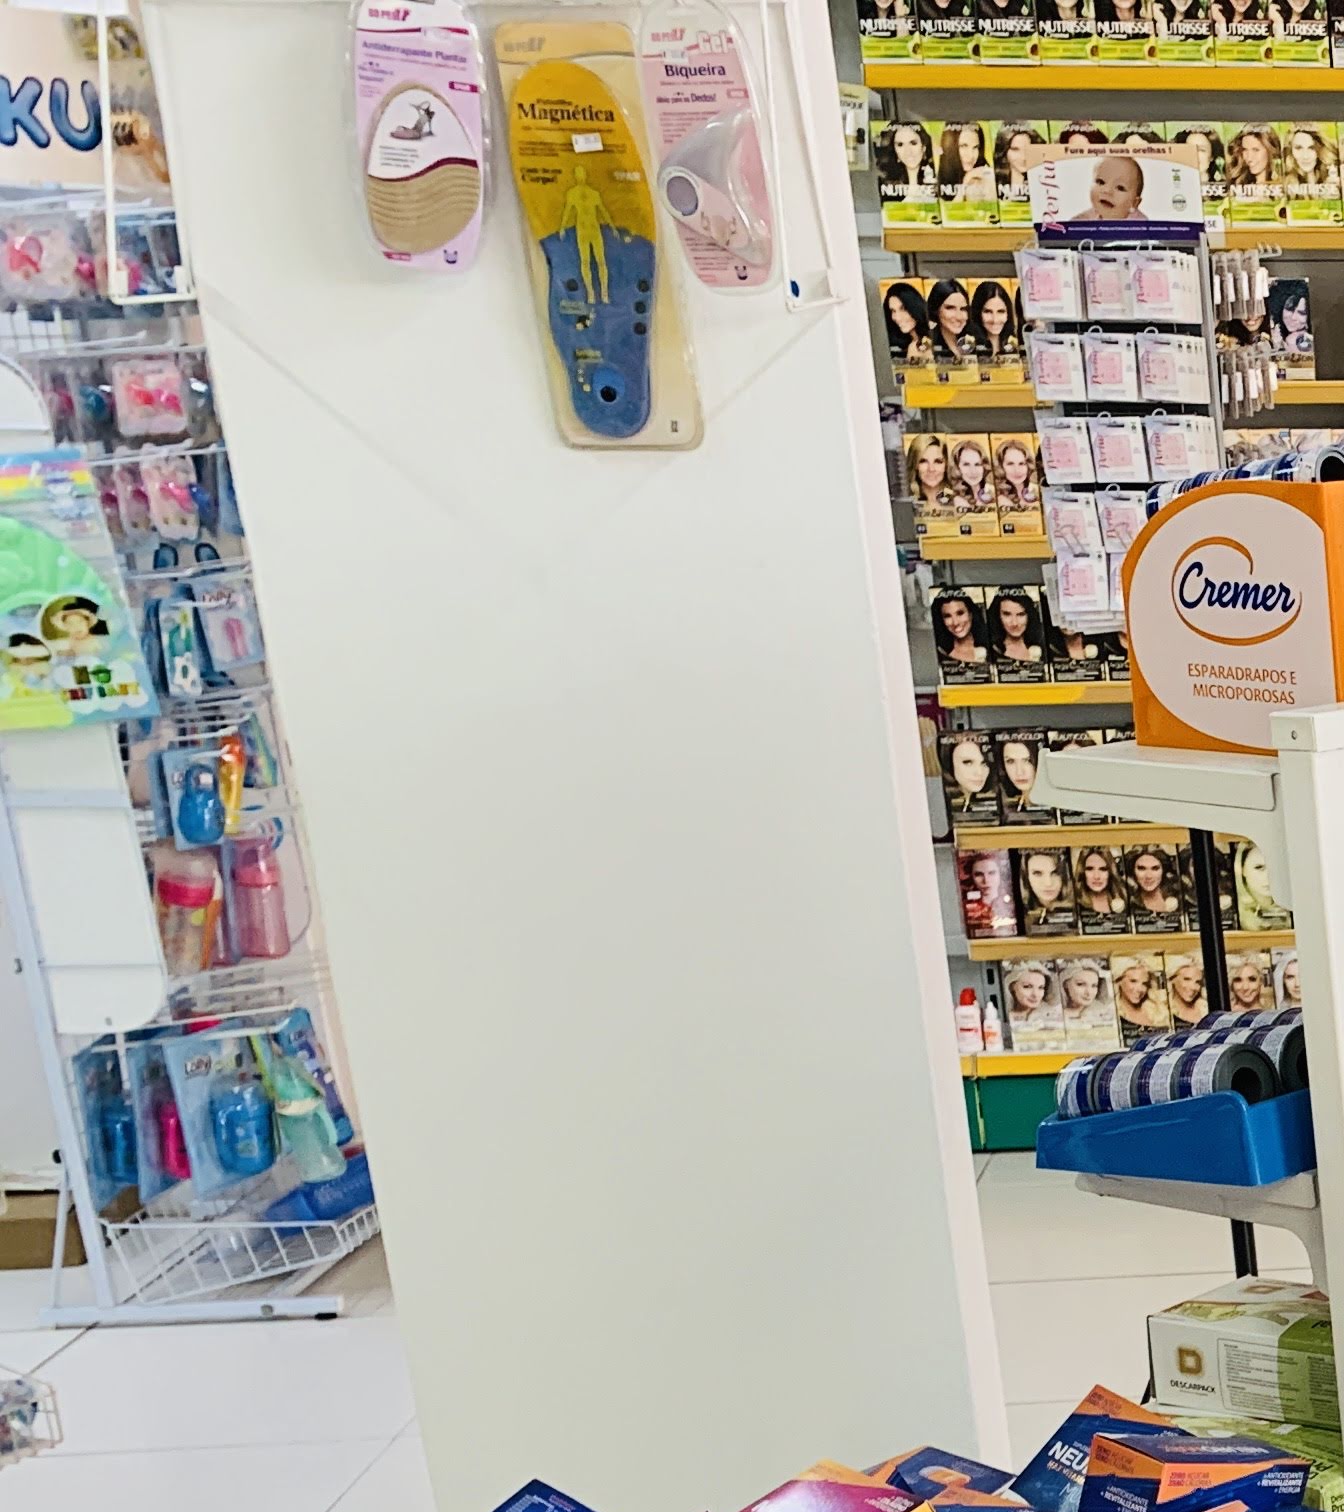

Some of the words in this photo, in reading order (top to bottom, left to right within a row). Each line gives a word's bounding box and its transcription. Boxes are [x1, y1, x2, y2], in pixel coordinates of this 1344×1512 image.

[665, 64, 725, 77] Biqueira
[518, 103, 615, 123] Magnética
[1178, 561, 1295, 614] Cremer
[1188, 663, 1286, 683] ESPARADRAPOS
[1288, 671, 1297, 685] E
[1192, 684, 1295, 704] MICROPOROSAS
